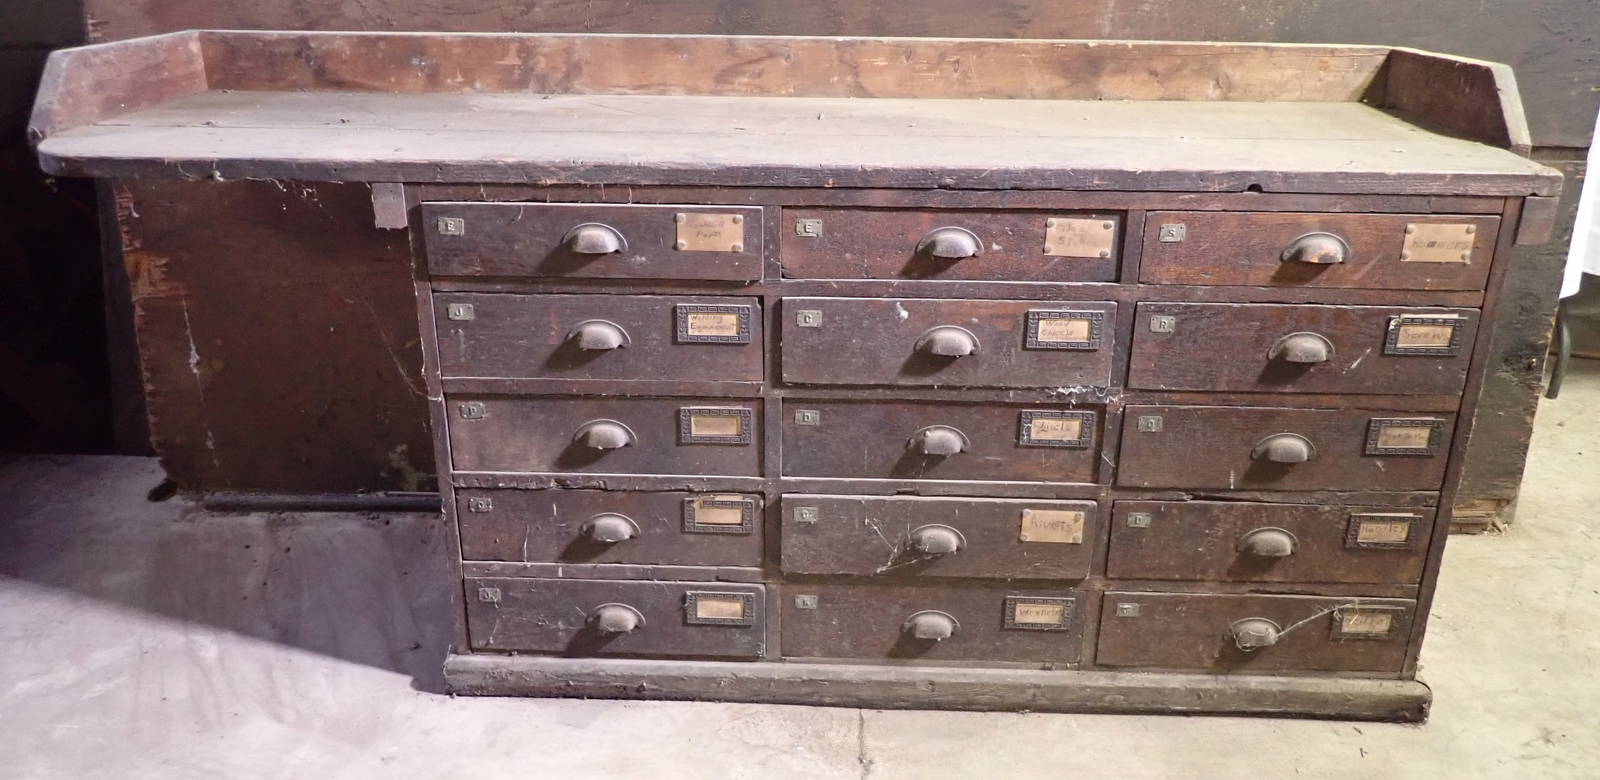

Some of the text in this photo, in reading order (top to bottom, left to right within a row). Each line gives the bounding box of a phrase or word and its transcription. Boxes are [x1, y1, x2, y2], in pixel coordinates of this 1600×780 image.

[804, 222, 814, 234] E
[1167, 228, 1177, 238] S
[455, 306, 464, 318] J
[1159, 319, 1168, 330] R
